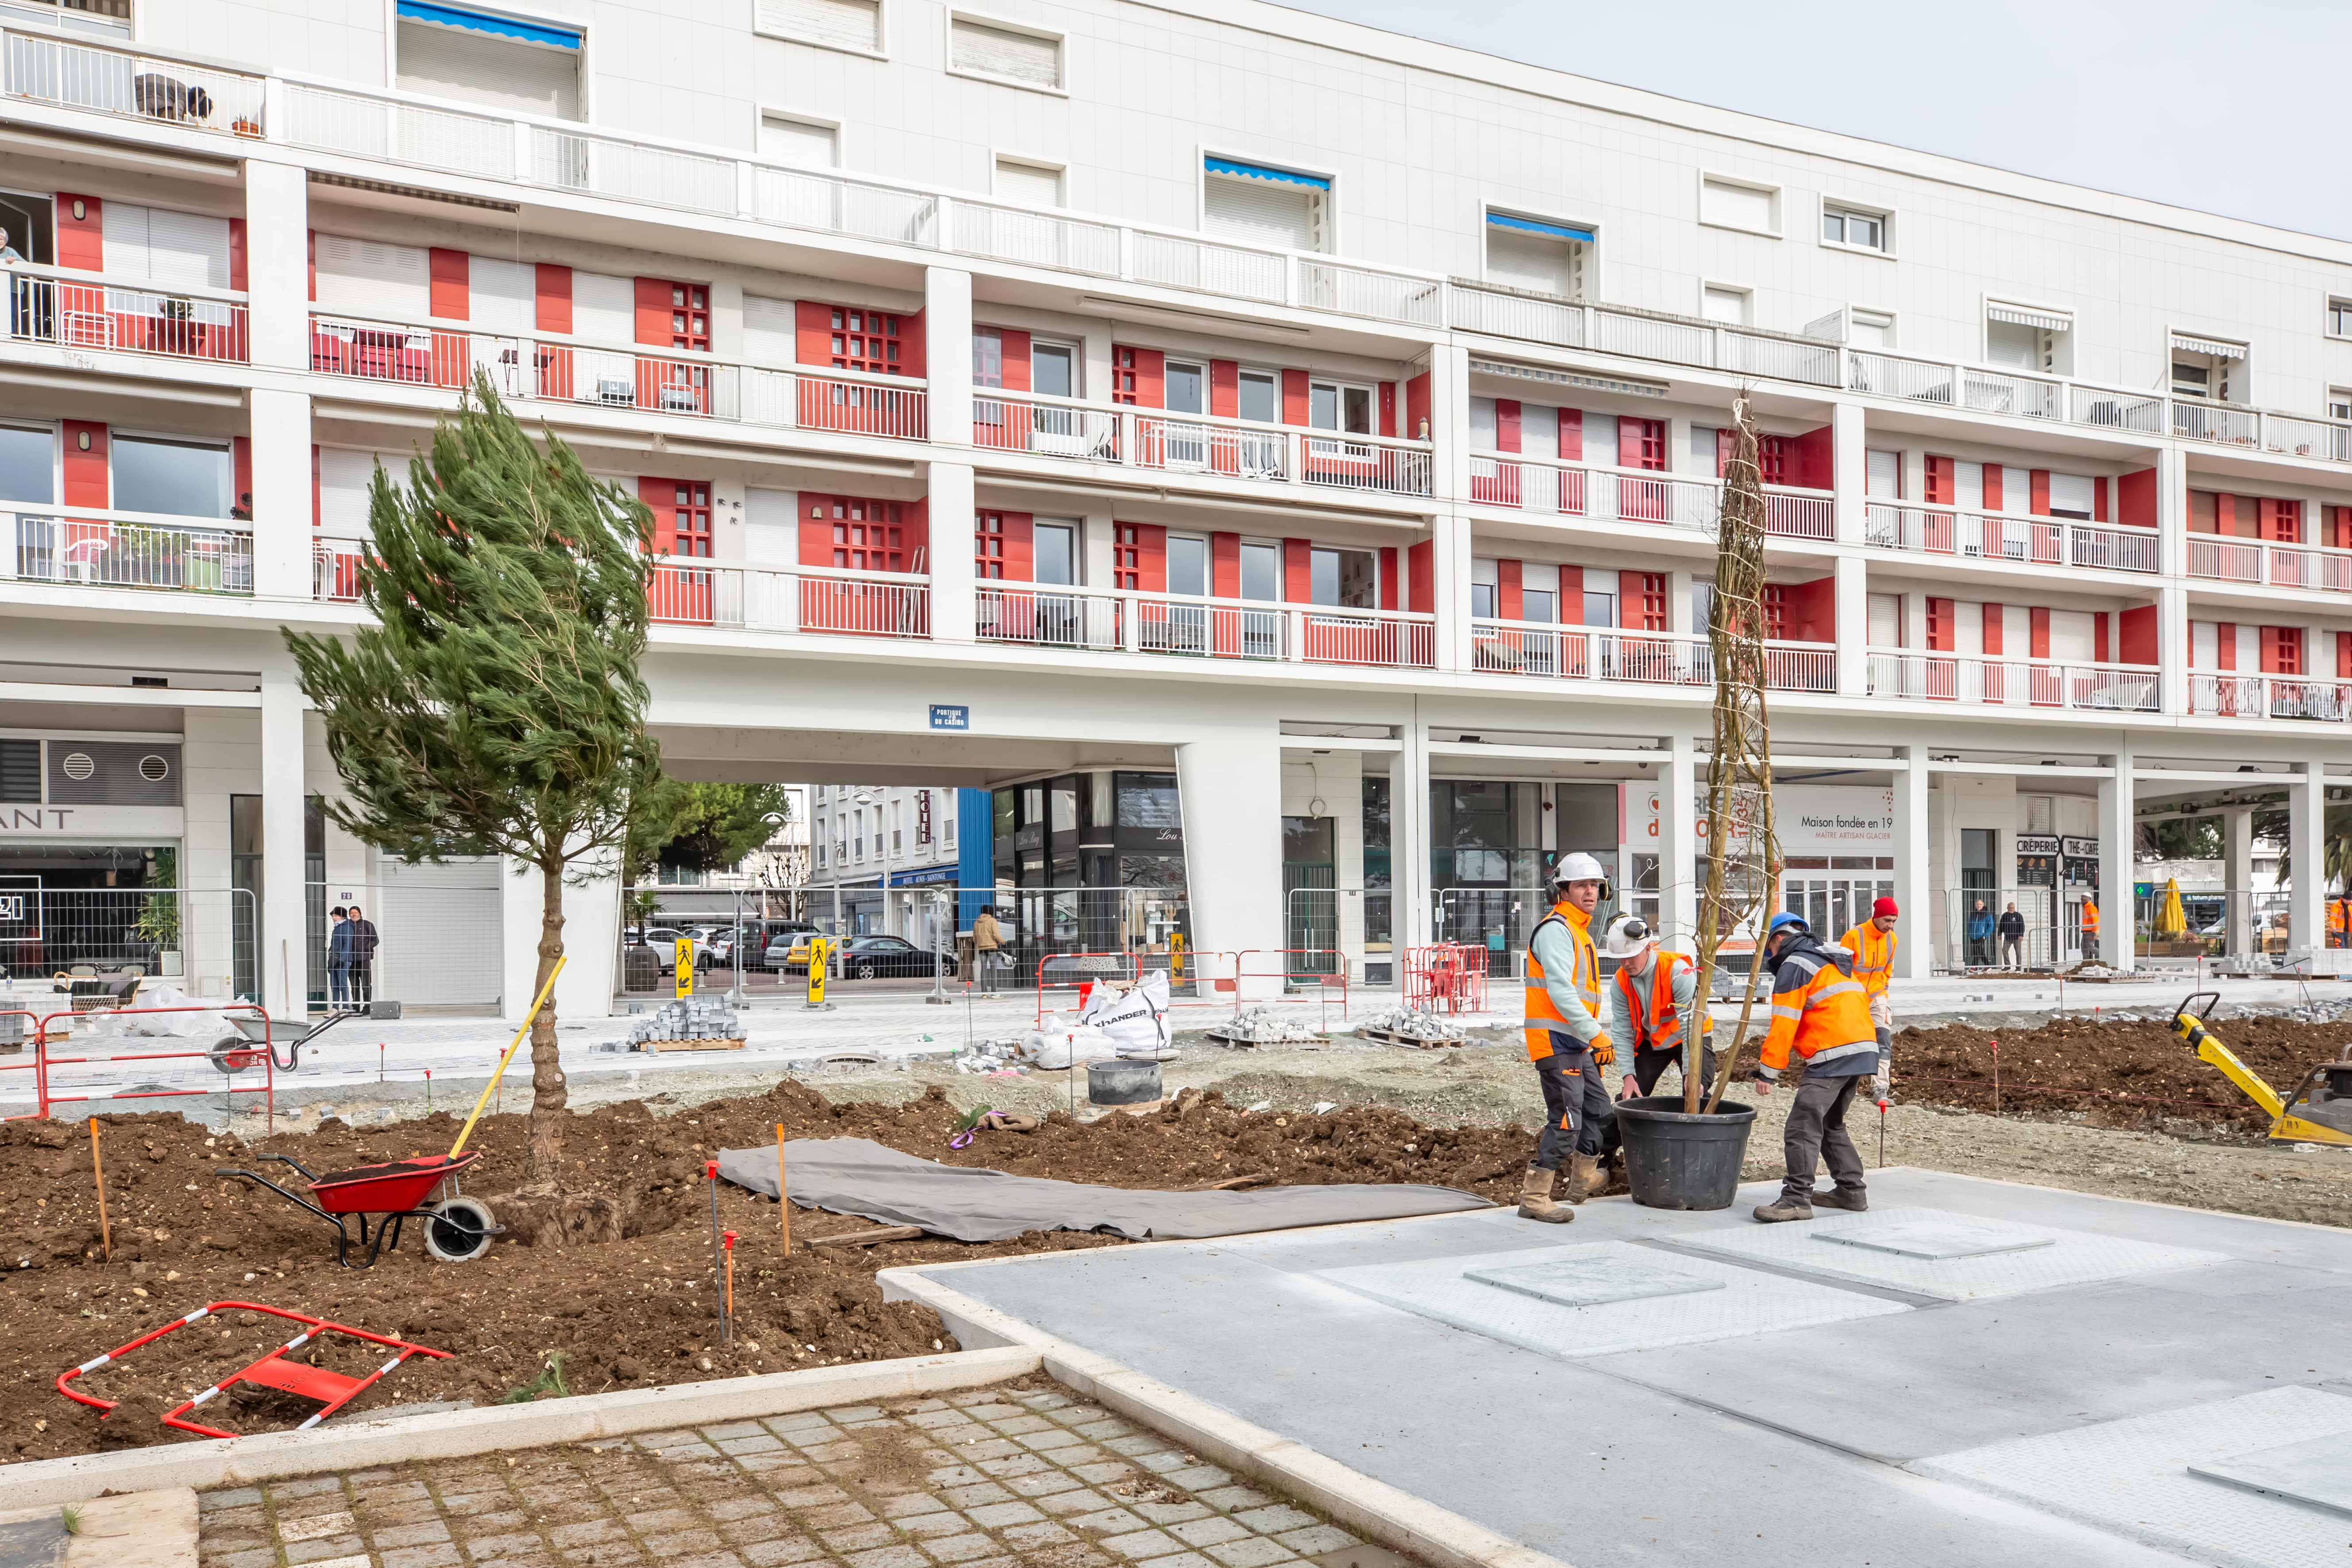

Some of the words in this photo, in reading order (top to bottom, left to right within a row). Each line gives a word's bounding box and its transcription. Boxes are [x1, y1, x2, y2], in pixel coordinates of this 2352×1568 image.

[920, 791, 930, 842] HOTEL
[1801, 816, 1834, 827] Maison
[1836, 815, 1866, 828] fondée
[1882, 817, 1893, 828] 19
[1156, 828, 1178, 840] Lou
[1815, 830, 1837, 839] MAÎTRE
[903, 876, 914, 885] HOTEL
